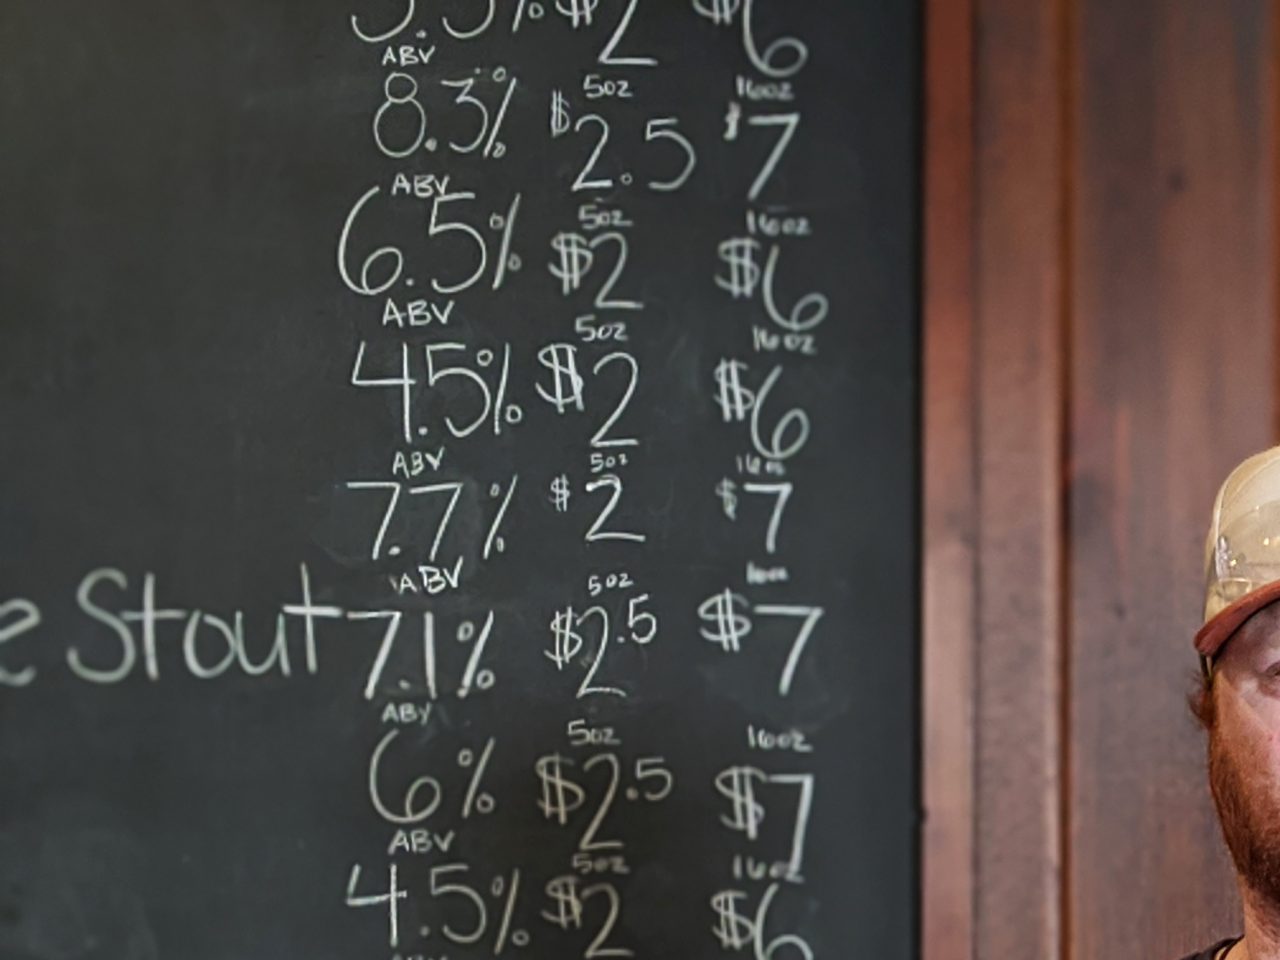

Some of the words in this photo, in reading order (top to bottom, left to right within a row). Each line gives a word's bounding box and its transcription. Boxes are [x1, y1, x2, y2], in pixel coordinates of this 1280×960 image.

[382, 46, 435, 66] ABV
[373, 68, 518, 158] 8.3%
[550, 89, 697, 192] $2.5
[723, 102, 801, 201] $7
[391, 174, 450, 197] ABV
[338, 187, 521, 296] 6.5%
[548, 232, 644, 309] $2
[715, 238, 829, 330] $6
[382, 299, 455, 326] ABV
[351, 341, 522, 443] 4.5%
[536, 343, 639, 447] $2
[714, 357, 811, 460] $6
[392, 447, 445, 476] ABV
[347, 474, 518, 560] 7.7%
[550, 473, 646, 542] $2
[715, 476, 793, 553] $7
[399, 556, 463, 595] ABV
[67, 563, 342, 683] Stout
[346, 609, 496, 700] 7.1%
[544, 594, 657, 699] $2.5
[698, 588, 824, 696] $7
[369, 728, 495, 824] 6%
[535, 752, 673, 852] $2.5
[714, 766, 815, 876] $7
[387, 831, 455, 854] ABV
[346, 863, 530, 956] 4.5%
[541, 874, 635, 960] $2
